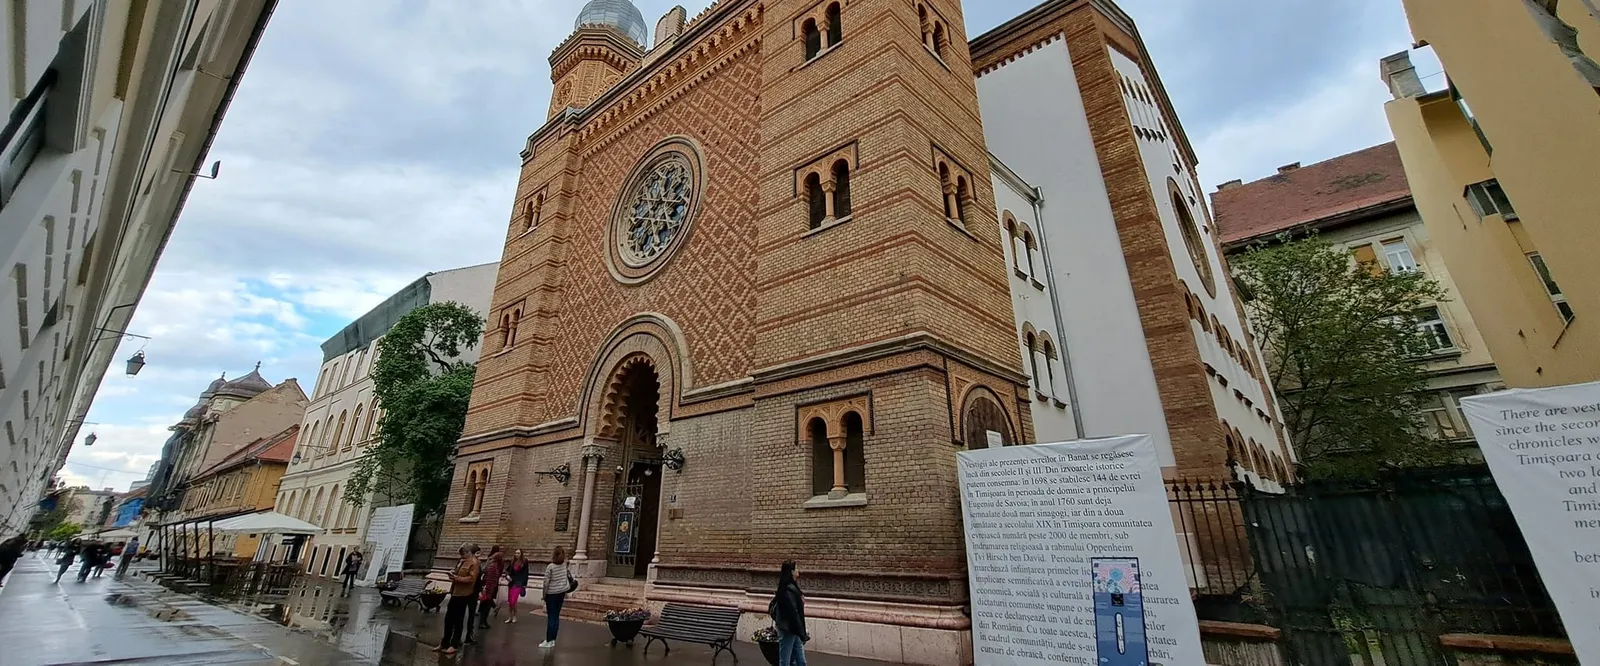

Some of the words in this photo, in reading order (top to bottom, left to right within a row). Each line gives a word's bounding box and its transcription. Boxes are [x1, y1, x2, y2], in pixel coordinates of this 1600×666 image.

[1500, 410, 1540, 420] There
[1544, 406, 1568, 416] are
[1496, 426, 1530, 436] since
[1535, 422, 1556, 432] the
[1508, 436, 1582, 450] chronicles
[965, 460, 988, 469] Vestigii
[1030, 456, 1056, 465] evreilor
[1068, 454, 1089, 462] Banat
[1060, 464, 1094, 472] izvoarele
[1096, 462, 1124, 471] istorice
[1031, 477, 1047, 485] 1698
[1059, 475, 1091, 484] stabilesc
[1092, 474, 1106, 482] 144
[1108, 472, 1118, 481] de
[1120, 471, 1141, 480] evrei
[1560, 470, 1586, 478] two
[1016, 488, 1044, 498] perioada
[1056, 487, 1084, 495] domnie
[1092, 484, 1136, 495] principelui
[1568, 482, 1597, 495] and
[968, 500, 994, 508] Eugeniu
[1058, 498, 1076, 506] 1760
[1095, 496, 1112, 506] deja
[1071, 508, 1081, 516] iar
[1083, 508, 1096, 516] din
[1104, 508, 1124, 516] doua
[1004, 520, 1034, 528] secolului
[1102, 519, 1153, 528] comunitatea
[1028, 533, 1046, 541] peste
[1048, 532, 1066, 540] 2000
[1068, 532, 1078, 540] de
[1114, 532, 1129, 540] sub
[1051, 543, 1084, 551] rabinului
[1086, 544, 1134, 554] Oppenheim
[974, 552, 984, 562] Tvi
[986, 553, 1008, 561] Hirsch
[1010, 554, 1022, 562] ben
[1051, 554, 1084, 563] Perioada
[1048, 566, 1079, 576] primelor
[976, 575, 1006, 584] implicare
[1062, 579, 1092, 588] evreilor
[977, 598, 1008, 607] dictaturii
[1008, 601, 1044, 610] comuniste
[1046, 602, 1076, 613] impune
[1143, 596, 1180, 605] taurarea
[1060, 616, 1074, 624] val
[1076, 616, 1084, 625] de
[1145, 621, 1166, 631] eilor
[978, 621, 990, 629] din
[1026, 624, 1038, 634] Cu
[1040, 626, 1058, 636] toate
[1146, 635, 1178, 646] vitatea
[980, 646, 1004, 655] cursuri
[1006, 647, 1015, 656] de
[988, 634, 1010, 644] cadrul
[1058, 642, 1079, 650] unde
[1079, 644, 1096, 652] s-au
[1148, 649, 1174, 660] rbări,
